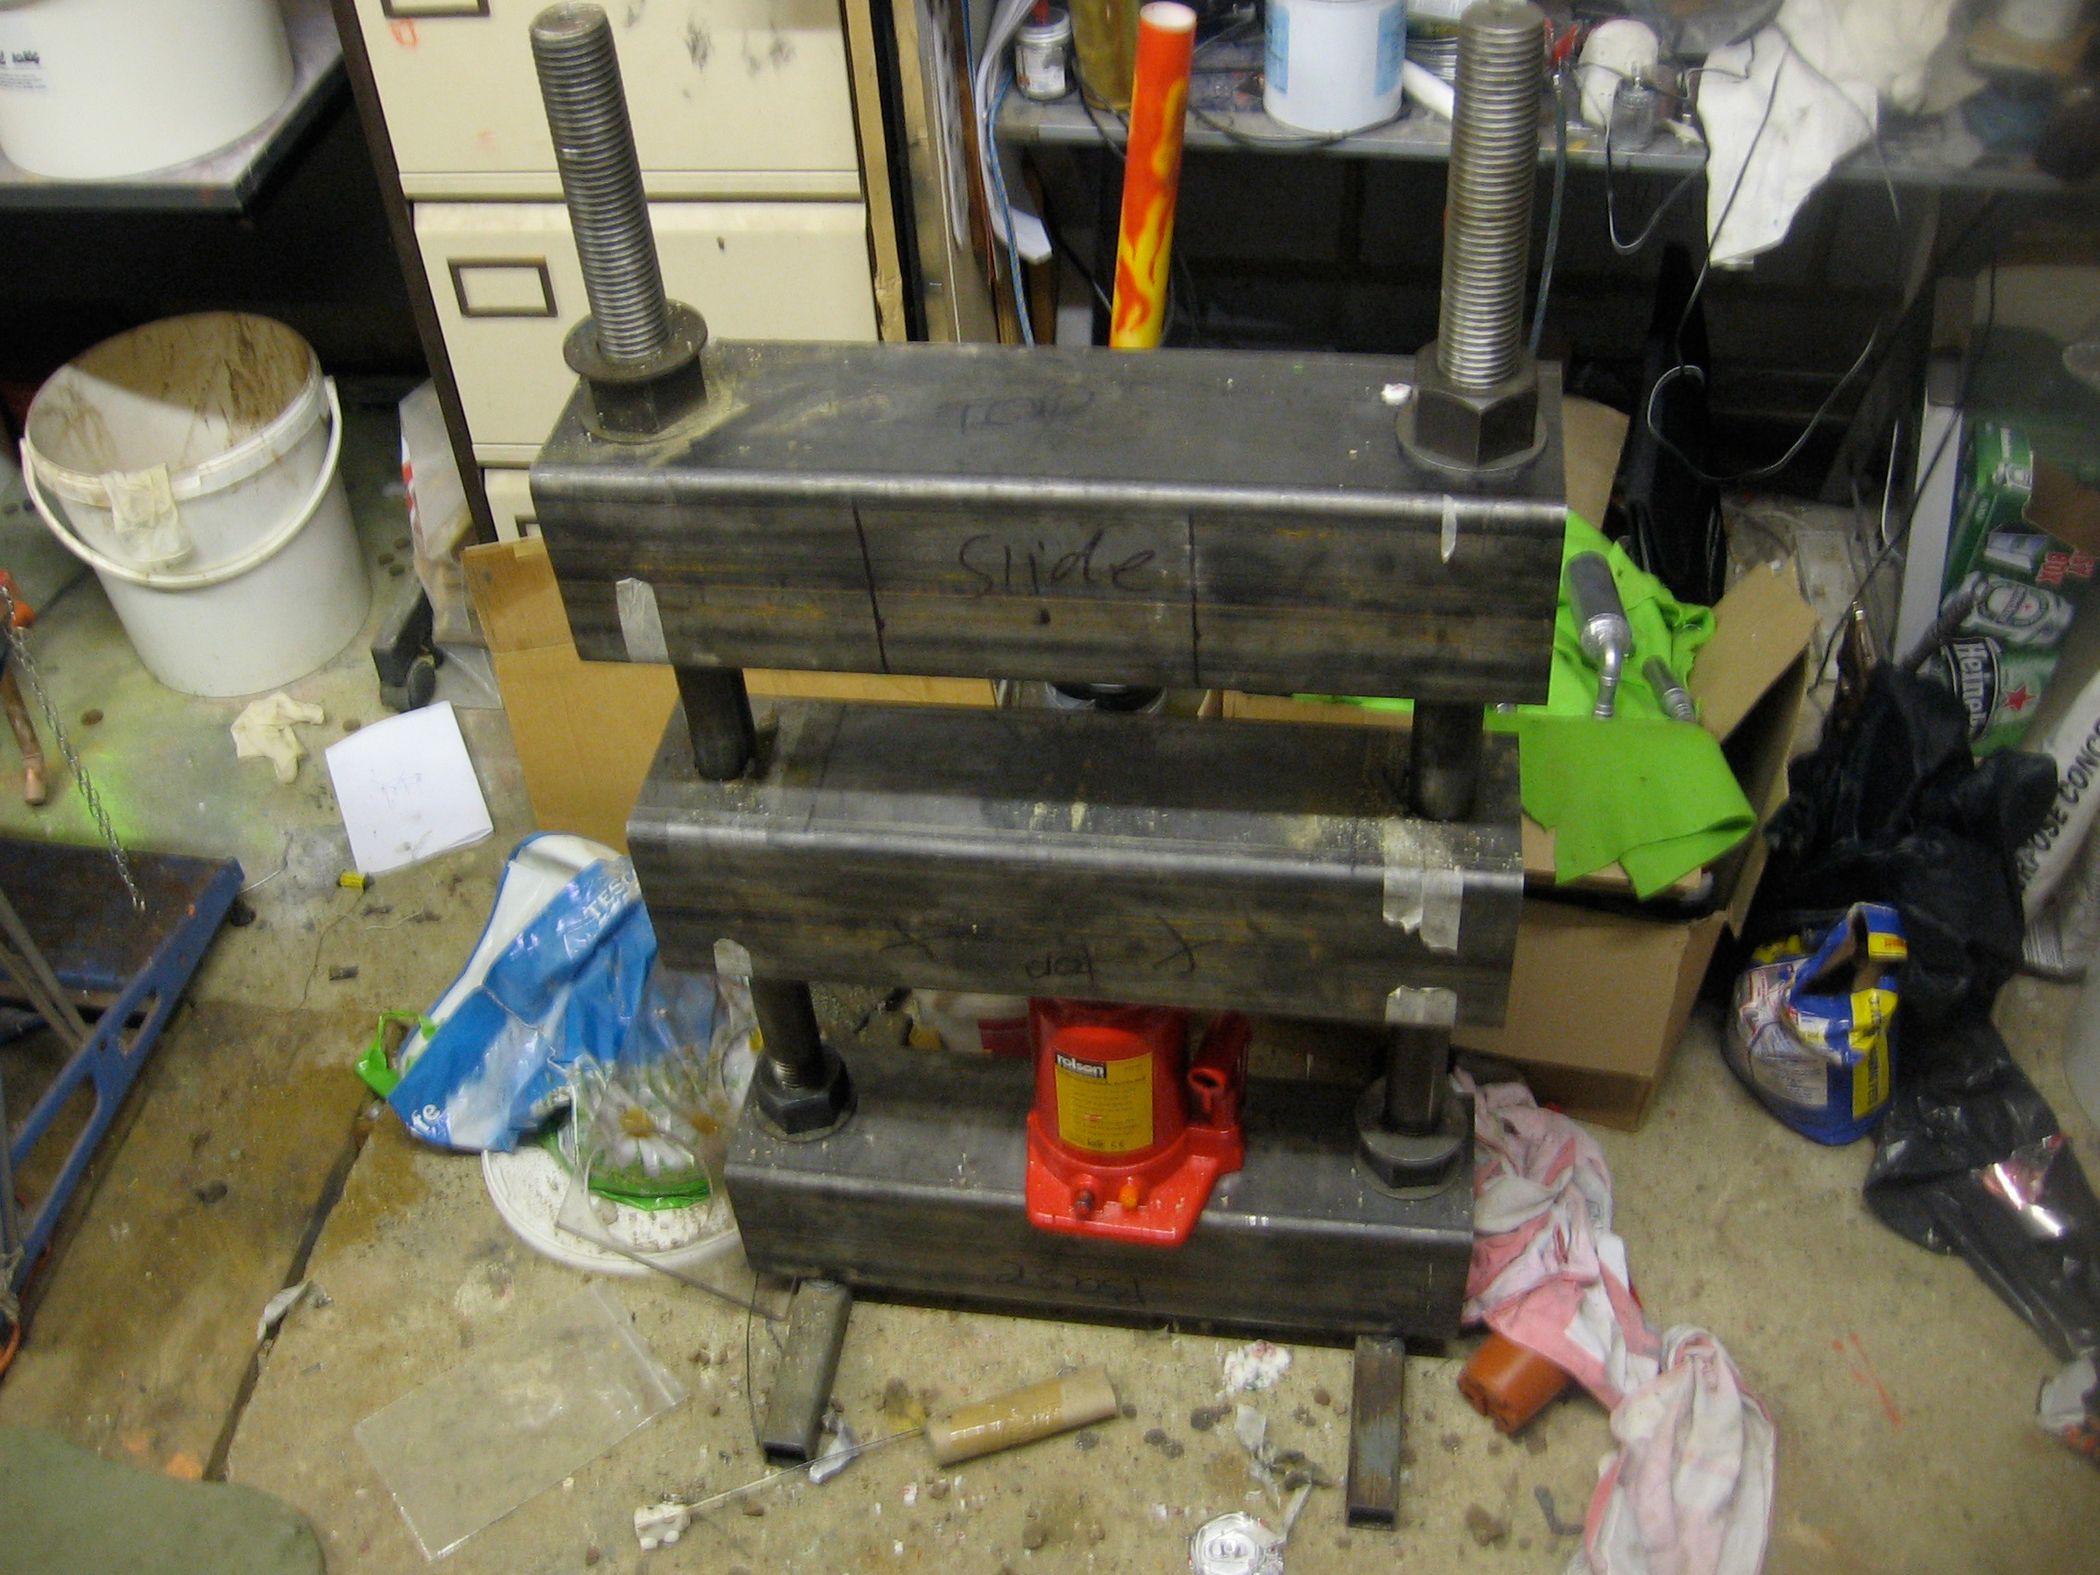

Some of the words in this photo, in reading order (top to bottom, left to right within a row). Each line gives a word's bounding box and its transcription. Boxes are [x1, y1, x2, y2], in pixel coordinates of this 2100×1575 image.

[959, 528, 1156, 600] Slide
[1953, 642, 1991, 739] Heinek
[1056, 1053, 1106, 1079] rolson
